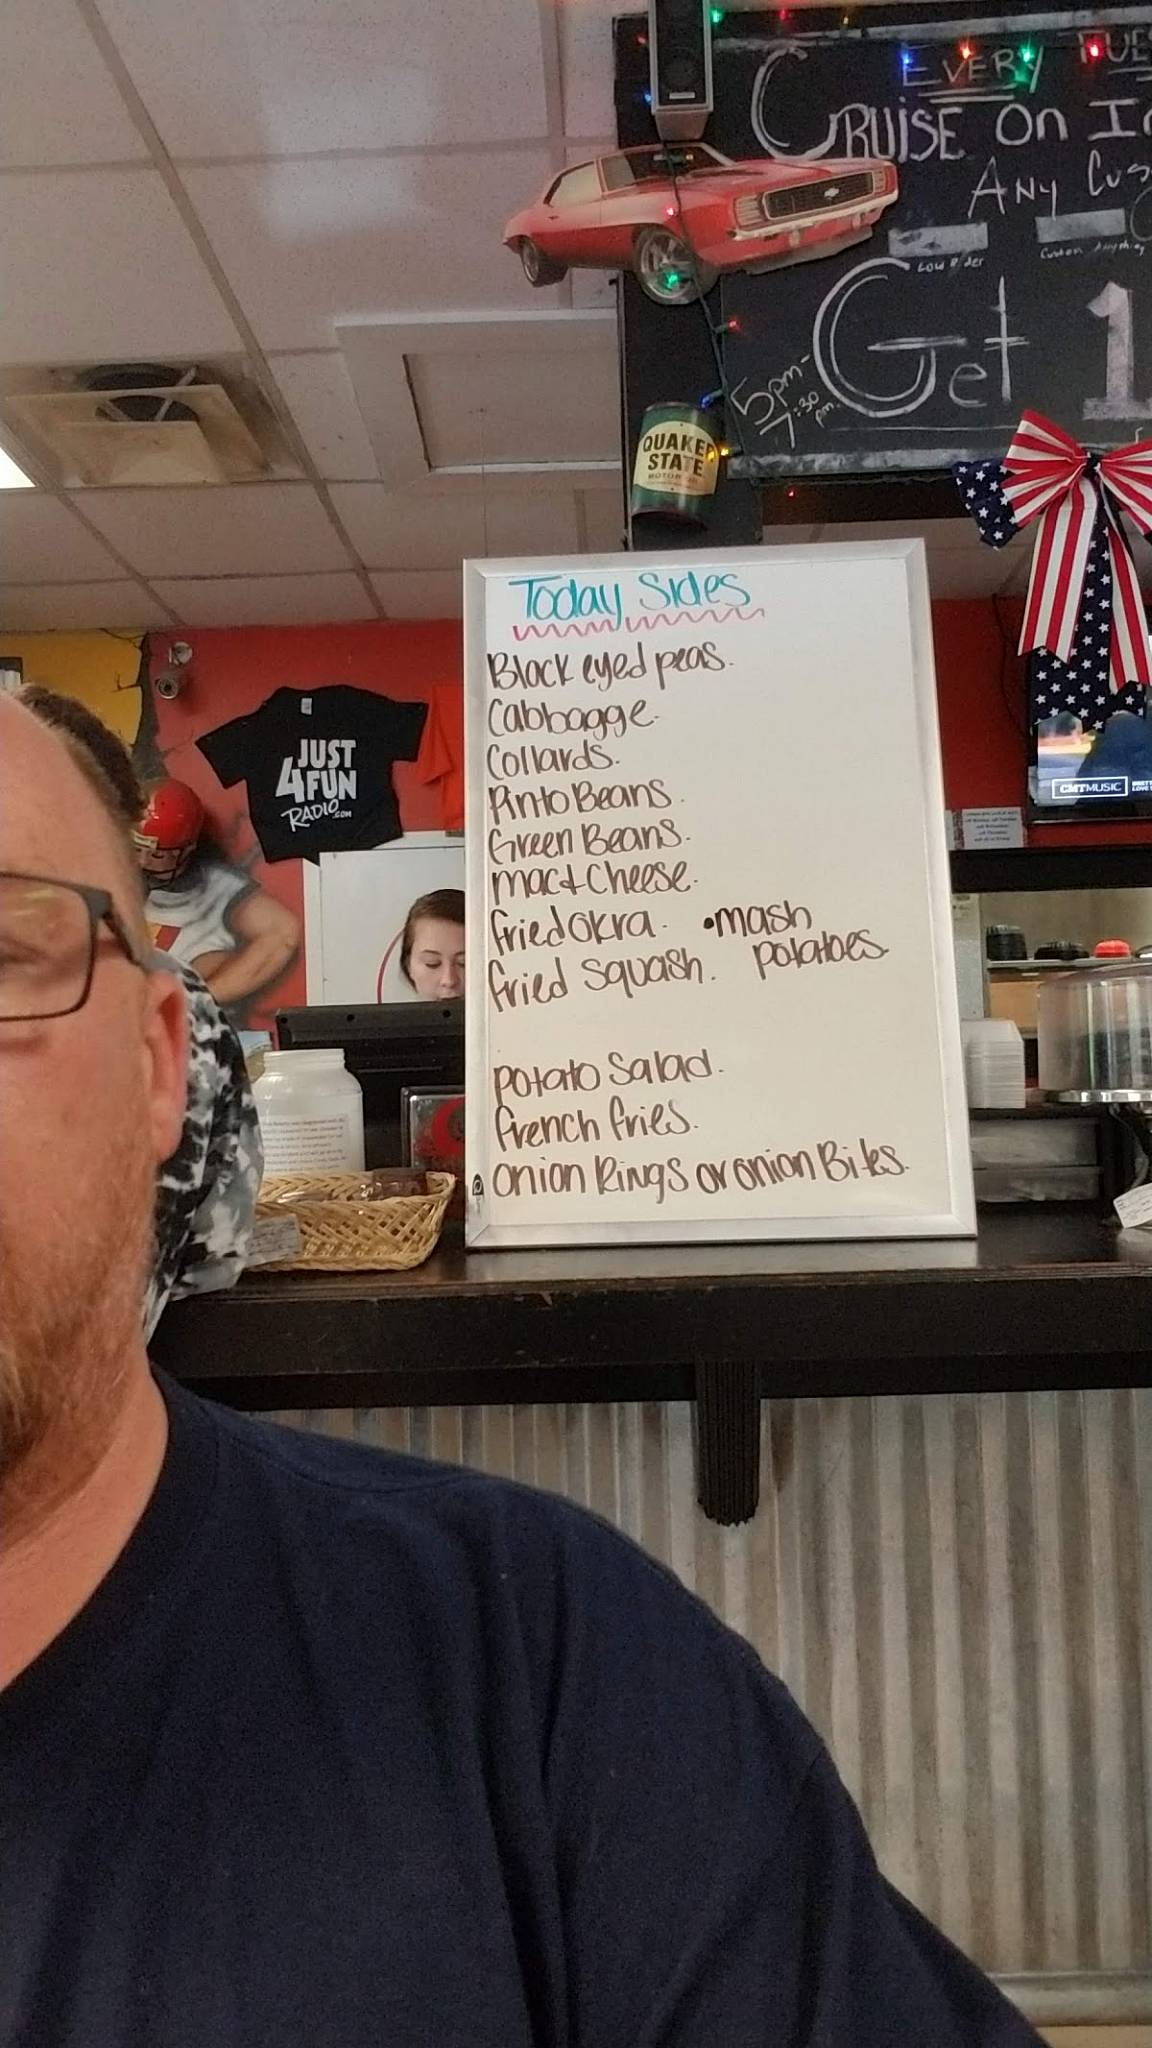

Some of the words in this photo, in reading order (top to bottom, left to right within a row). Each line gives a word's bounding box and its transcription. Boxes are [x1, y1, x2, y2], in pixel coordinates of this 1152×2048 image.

[1058, 28, 1152, 64] TUE
[1088, 149, 1152, 197] Cus
[813, 257, 1030, 419] Get
[647, 452, 705, 477] STATE
[508, 575, 622, 632] Today
[638, 570, 751, 610] Sides
[487, 651, 575, 691] Black
[582, 641, 648, 692] eyed
[298, 739, 356, 768] JUST
[275, 756, 305, 804] 4
[306, 768, 357, 801] FUN
[488, 828, 573, 865] Green
